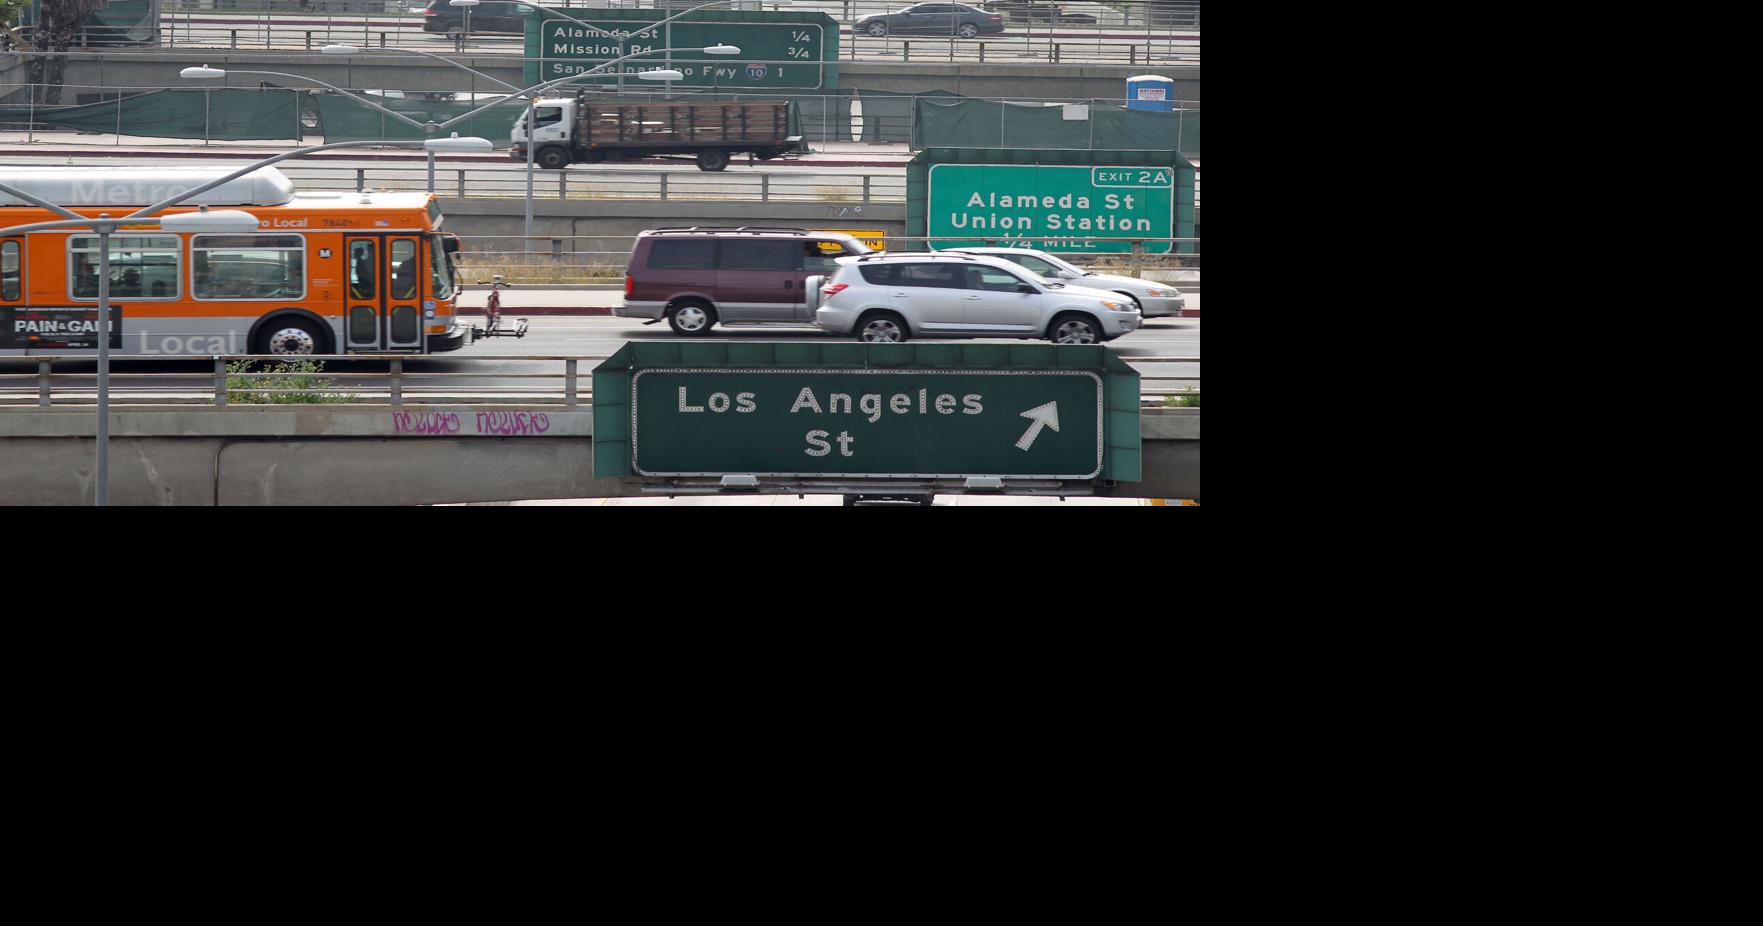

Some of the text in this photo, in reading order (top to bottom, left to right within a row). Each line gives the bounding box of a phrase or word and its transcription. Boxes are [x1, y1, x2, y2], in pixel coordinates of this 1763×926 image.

[554, 27, 630, 38] Alameda
[640, 28, 658, 39] St
[554, 43, 810, 59] Mission Rd 3/4
[553, 63, 585, 74] San
[703, 66, 736, 79] Fwy
[750, 69, 763, 77] 10
[777, 67, 783, 77] 1
[1099, 171, 1167, 183] EXIT 2A
[71, 180, 187, 204] Metro
[967, 192, 1134, 210] Alameda St
[274, 218, 308, 227] Local
[951, 212, 1151, 232] Union Station
[1044, 235, 1096, 247] MILE
[140, 330, 236, 355] Local
[678, 386, 984, 423] Los Angeles
[804, 429, 854, 457] St
